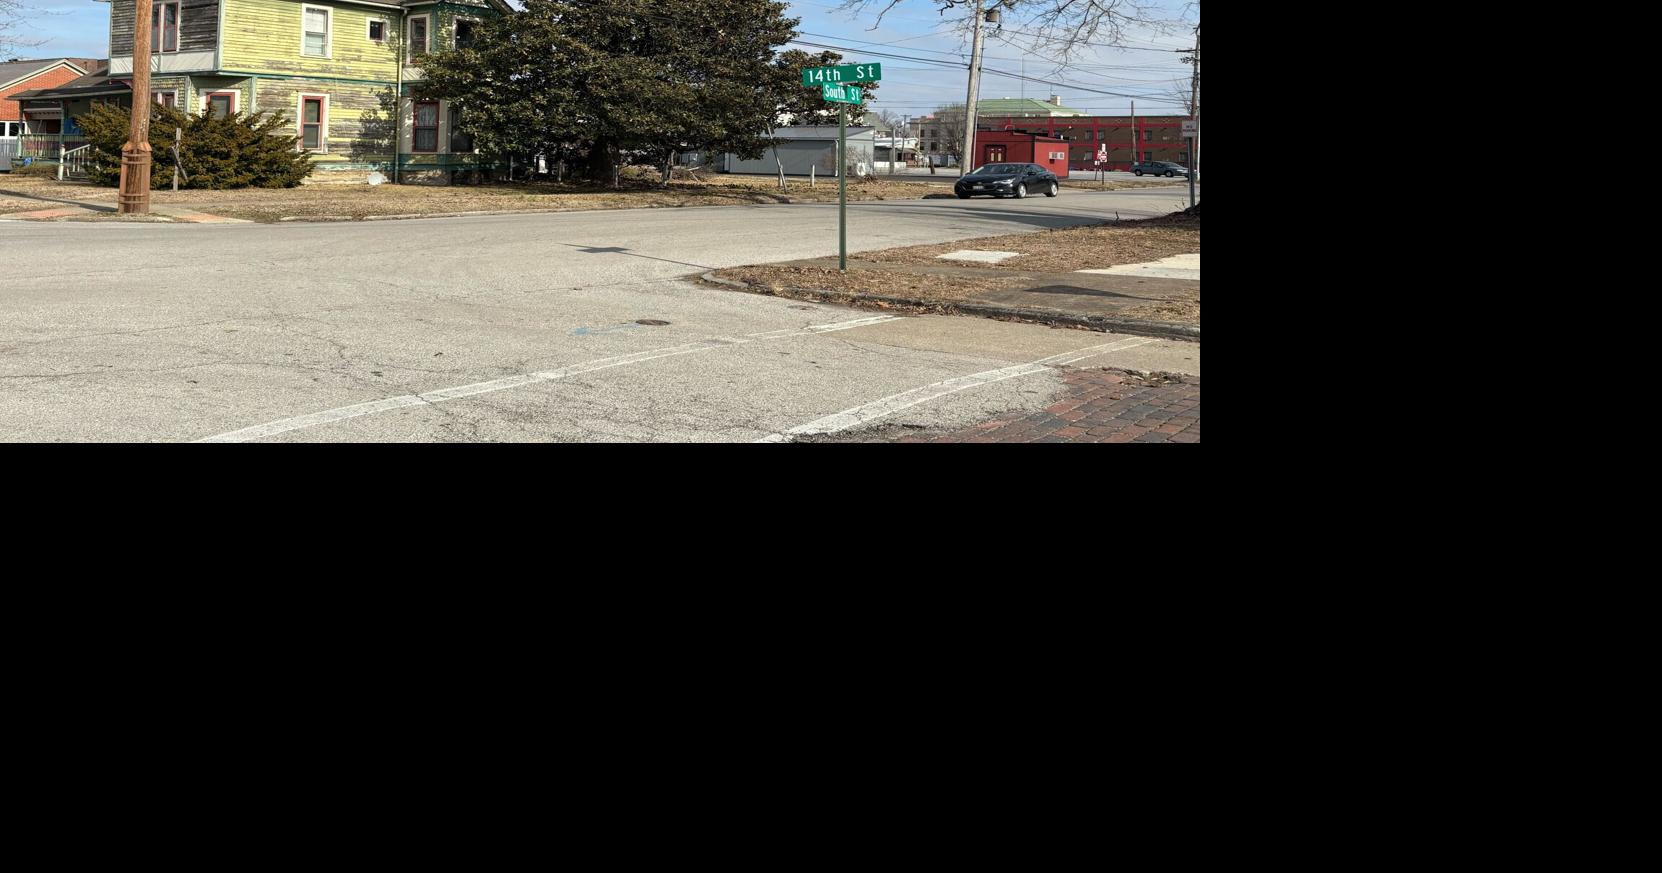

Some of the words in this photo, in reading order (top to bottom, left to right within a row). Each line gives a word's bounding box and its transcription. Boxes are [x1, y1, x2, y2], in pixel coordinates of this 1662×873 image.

[809, 68, 841, 83] 14th
[856, 65, 874, 79] St
[825, 84, 846, 100] South
[851, 88, 860, 101] St
